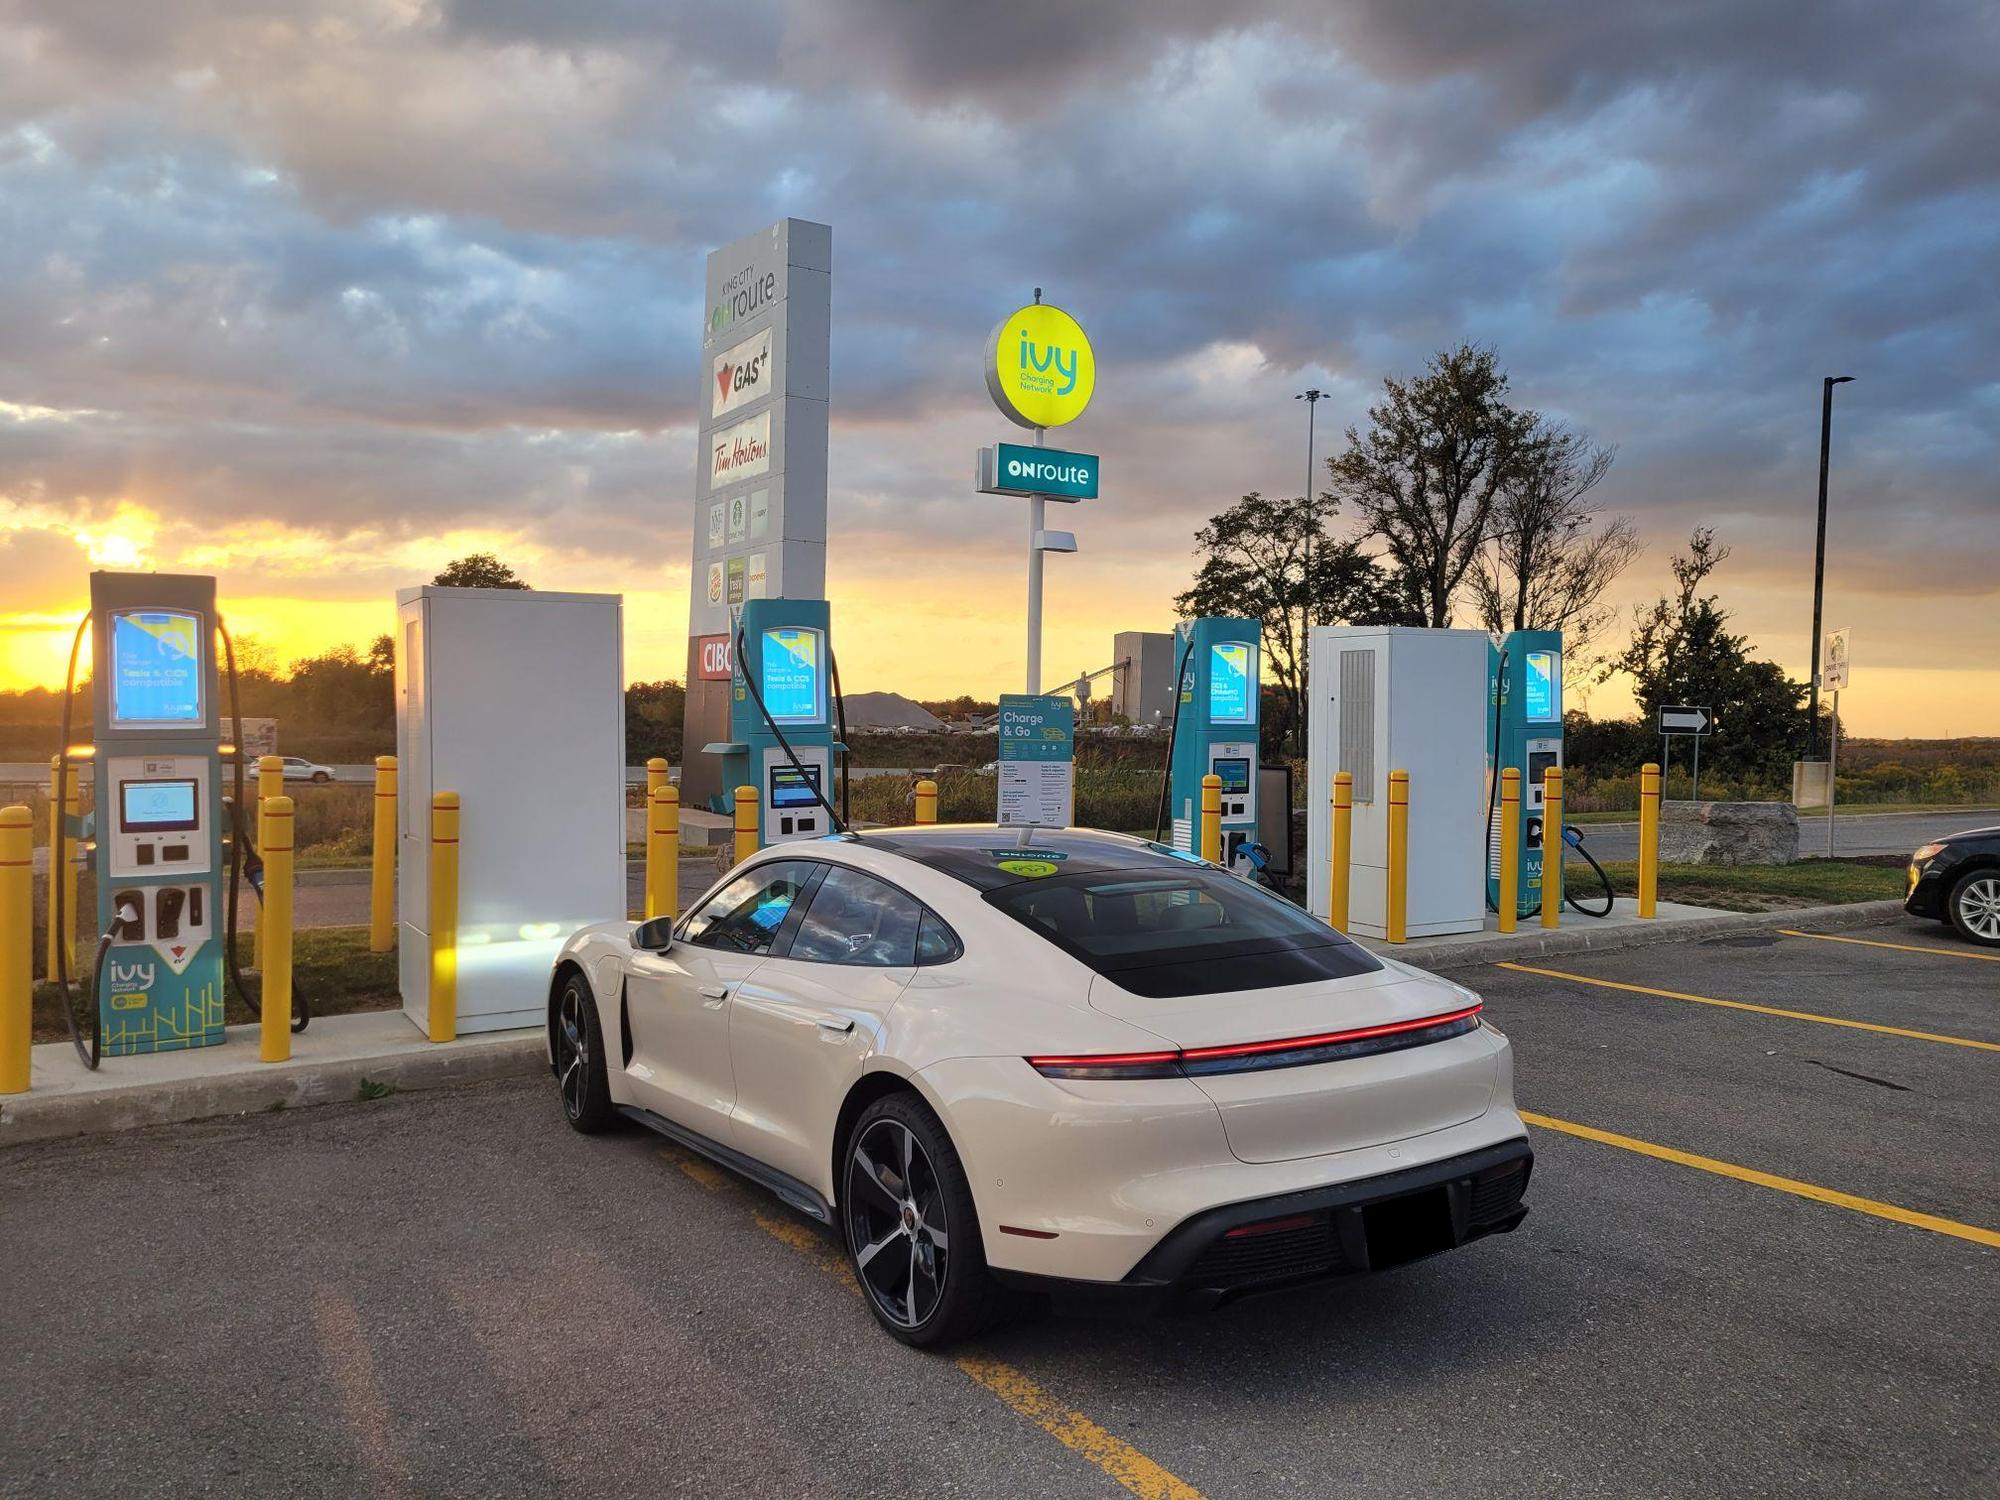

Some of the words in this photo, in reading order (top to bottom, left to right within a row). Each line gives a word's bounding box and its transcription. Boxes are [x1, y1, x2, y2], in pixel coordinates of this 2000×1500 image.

[739, 264, 755, 286] CITY
[1020, 329, 1077, 396] ivy
[1020, 372, 1055, 386] Charging
[1020, 381, 1053, 393] Network
[715, 443, 731, 475] Tim
[731, 436, 767, 468] Hortons
[704, 641, 732, 672] CIBC
[1003, 711, 1044, 726] Charge
[1003, 725, 1012, 736] &
[1015, 726, 1031, 737] Go
[1528, 858, 1543, 877] ivy
[111, 960, 155, 990] ivy
